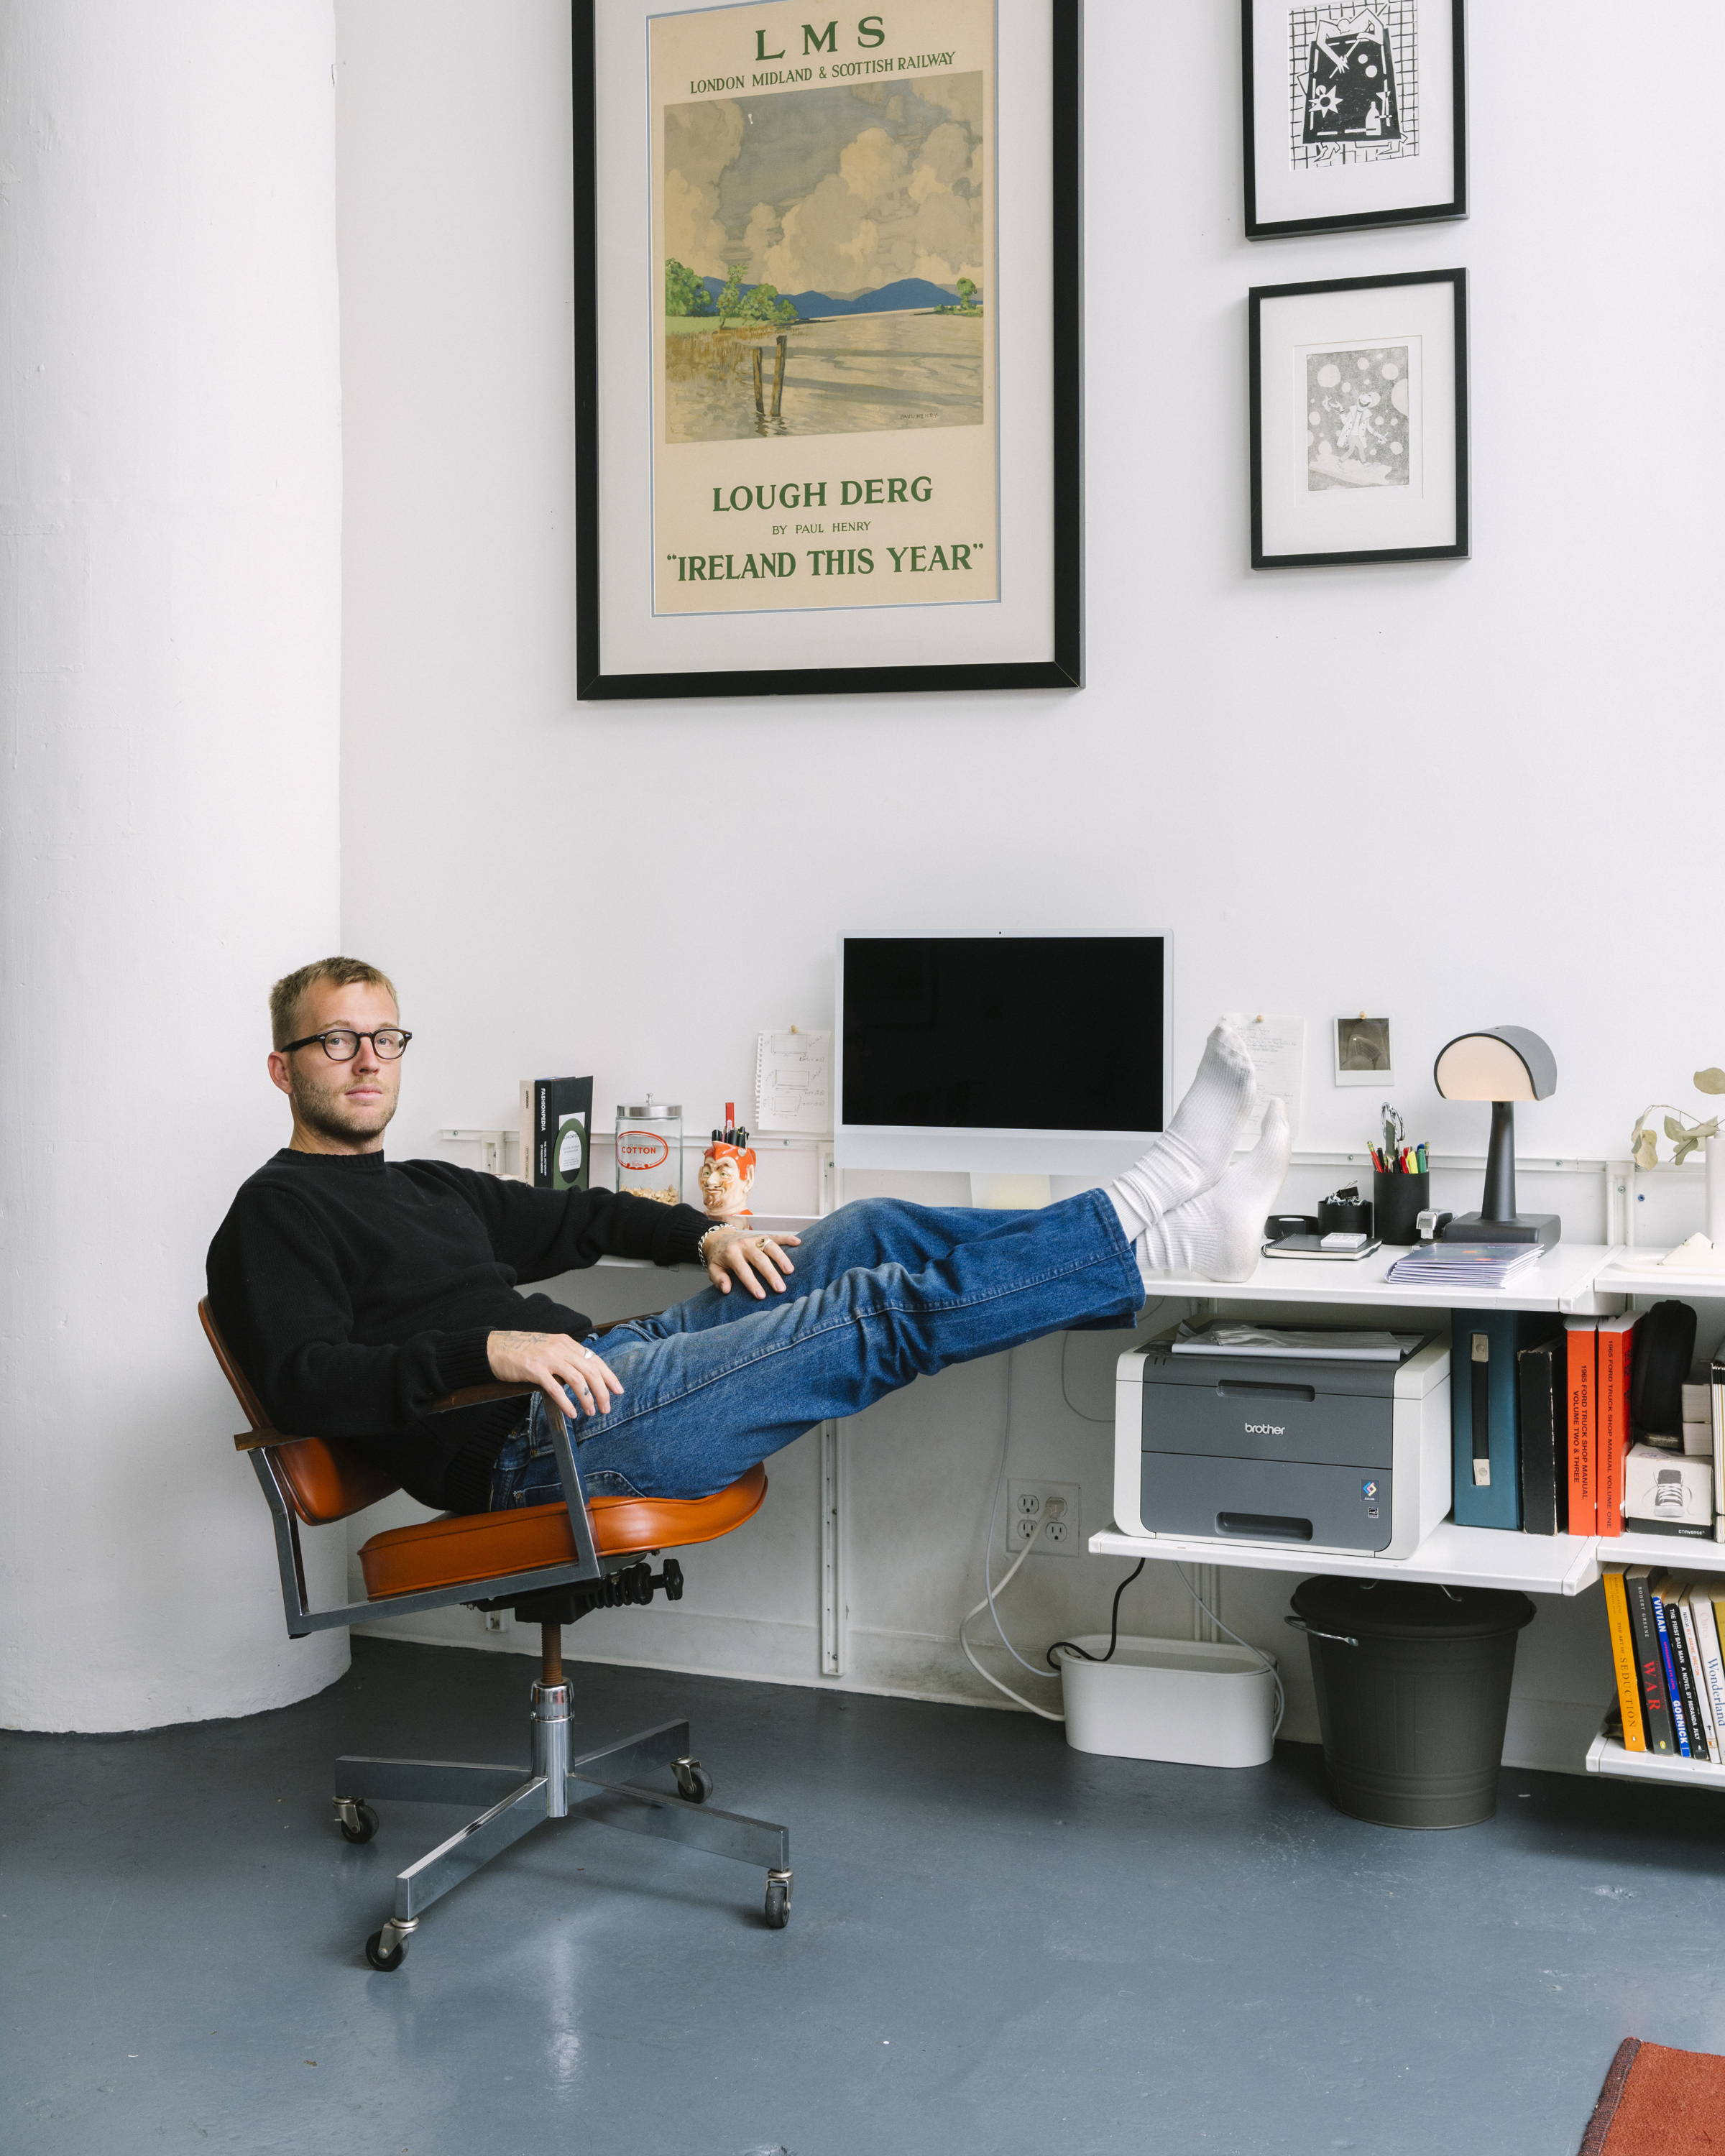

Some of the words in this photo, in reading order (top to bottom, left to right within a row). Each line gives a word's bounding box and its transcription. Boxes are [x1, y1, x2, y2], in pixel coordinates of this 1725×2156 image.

[690, 75, 745, 94] LONDON
[752, 68, 813, 87] MIDLAND
[819, 65, 828, 79] &
[832, 58, 894, 78] SCOTTISH
[898, 51, 956, 70] RAILWAY
[712, 482, 827, 512] LOUGH
[840, 476, 933, 505] DERG
[772, 525, 787, 535] BY
[795, 523, 824, 533] PAUL
[832, 521, 872, 532] HENRY
[667, 552, 796, 581] "IRELAND
[806, 548, 875, 576] THIS
[886, 543, 984, 573] YEAR"
[1244, 1422, 1285, 1435] brother
[1643, 1661, 1661, 1710] WAR
[1654, 1599, 1668, 1632] VIVIAN
[1673, 1700, 1689, 1743] GORNICK
[1620, 1657, 1637, 1727] SEDUCTION
[1708, 1658, 1725, 1726] Wonderland
[1688, 1700, 1698, 1726] MIRANDA
